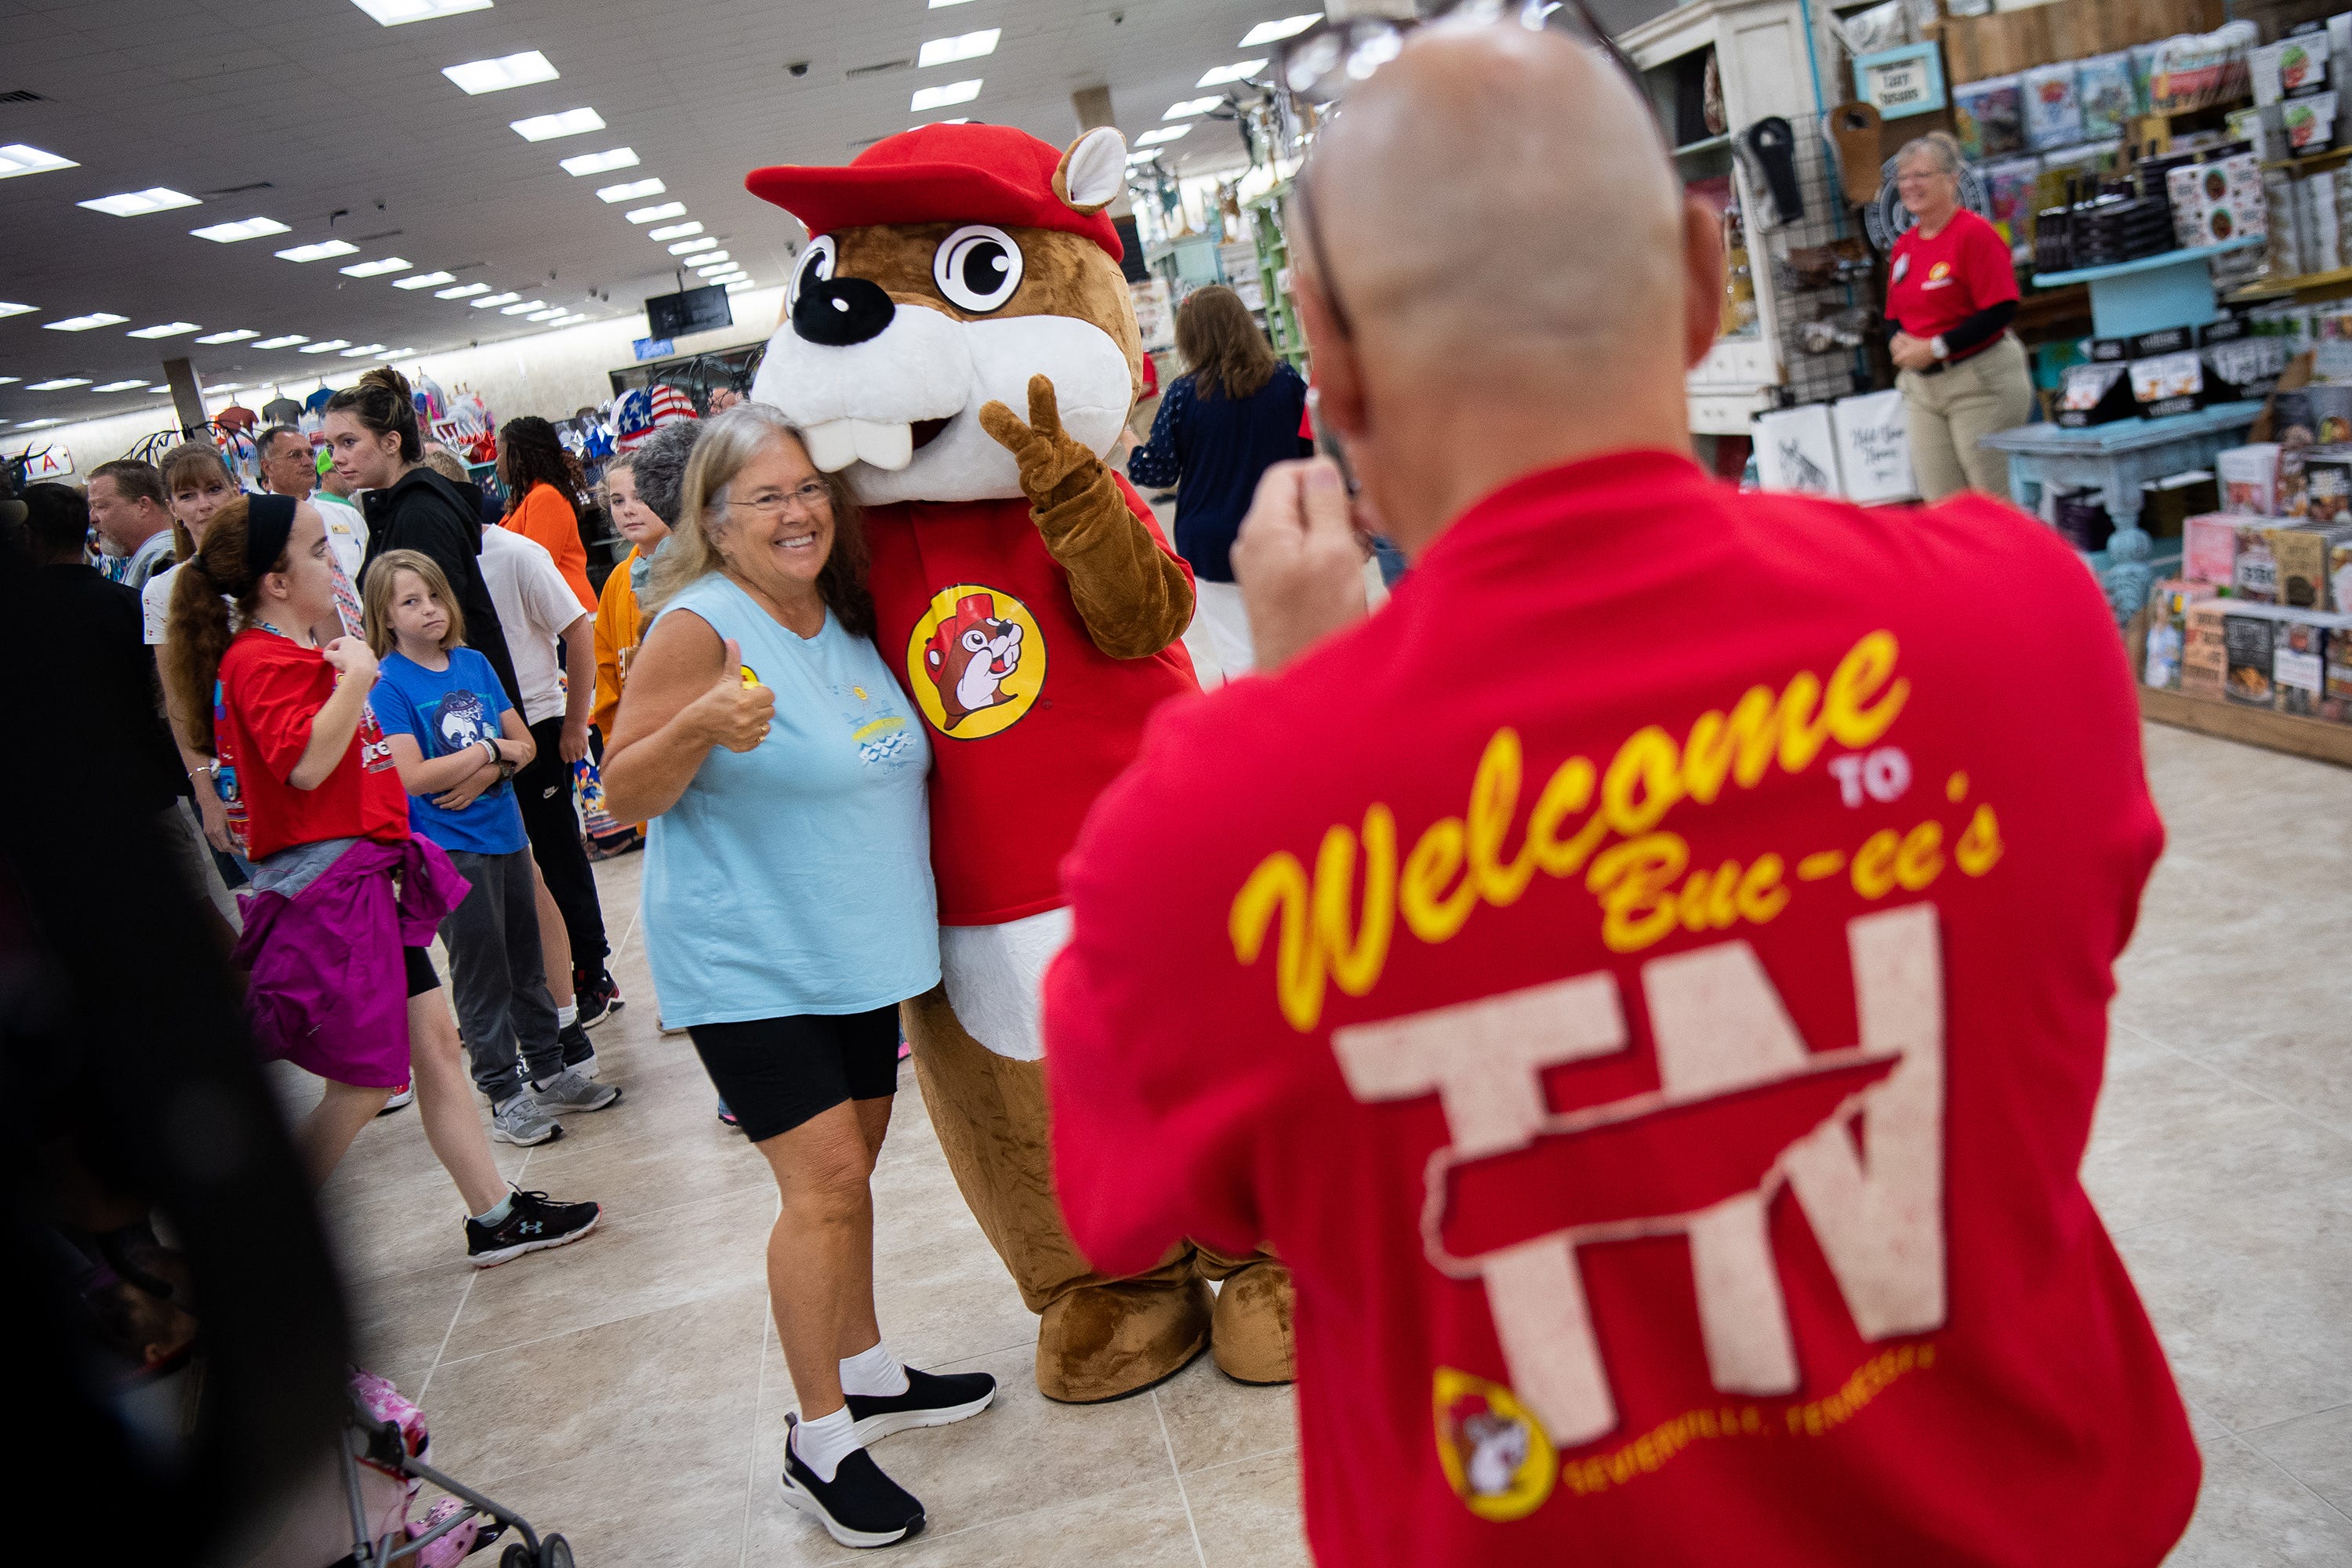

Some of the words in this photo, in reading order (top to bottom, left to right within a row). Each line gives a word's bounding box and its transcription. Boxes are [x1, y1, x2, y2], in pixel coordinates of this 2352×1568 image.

[1230, 629, 1910, 1033] Welcome
[1584, 771, 2004, 953] Buc-ee's
[1831, 746, 1911, 808] TO
[1332, 902, 1947, 1450] TN
